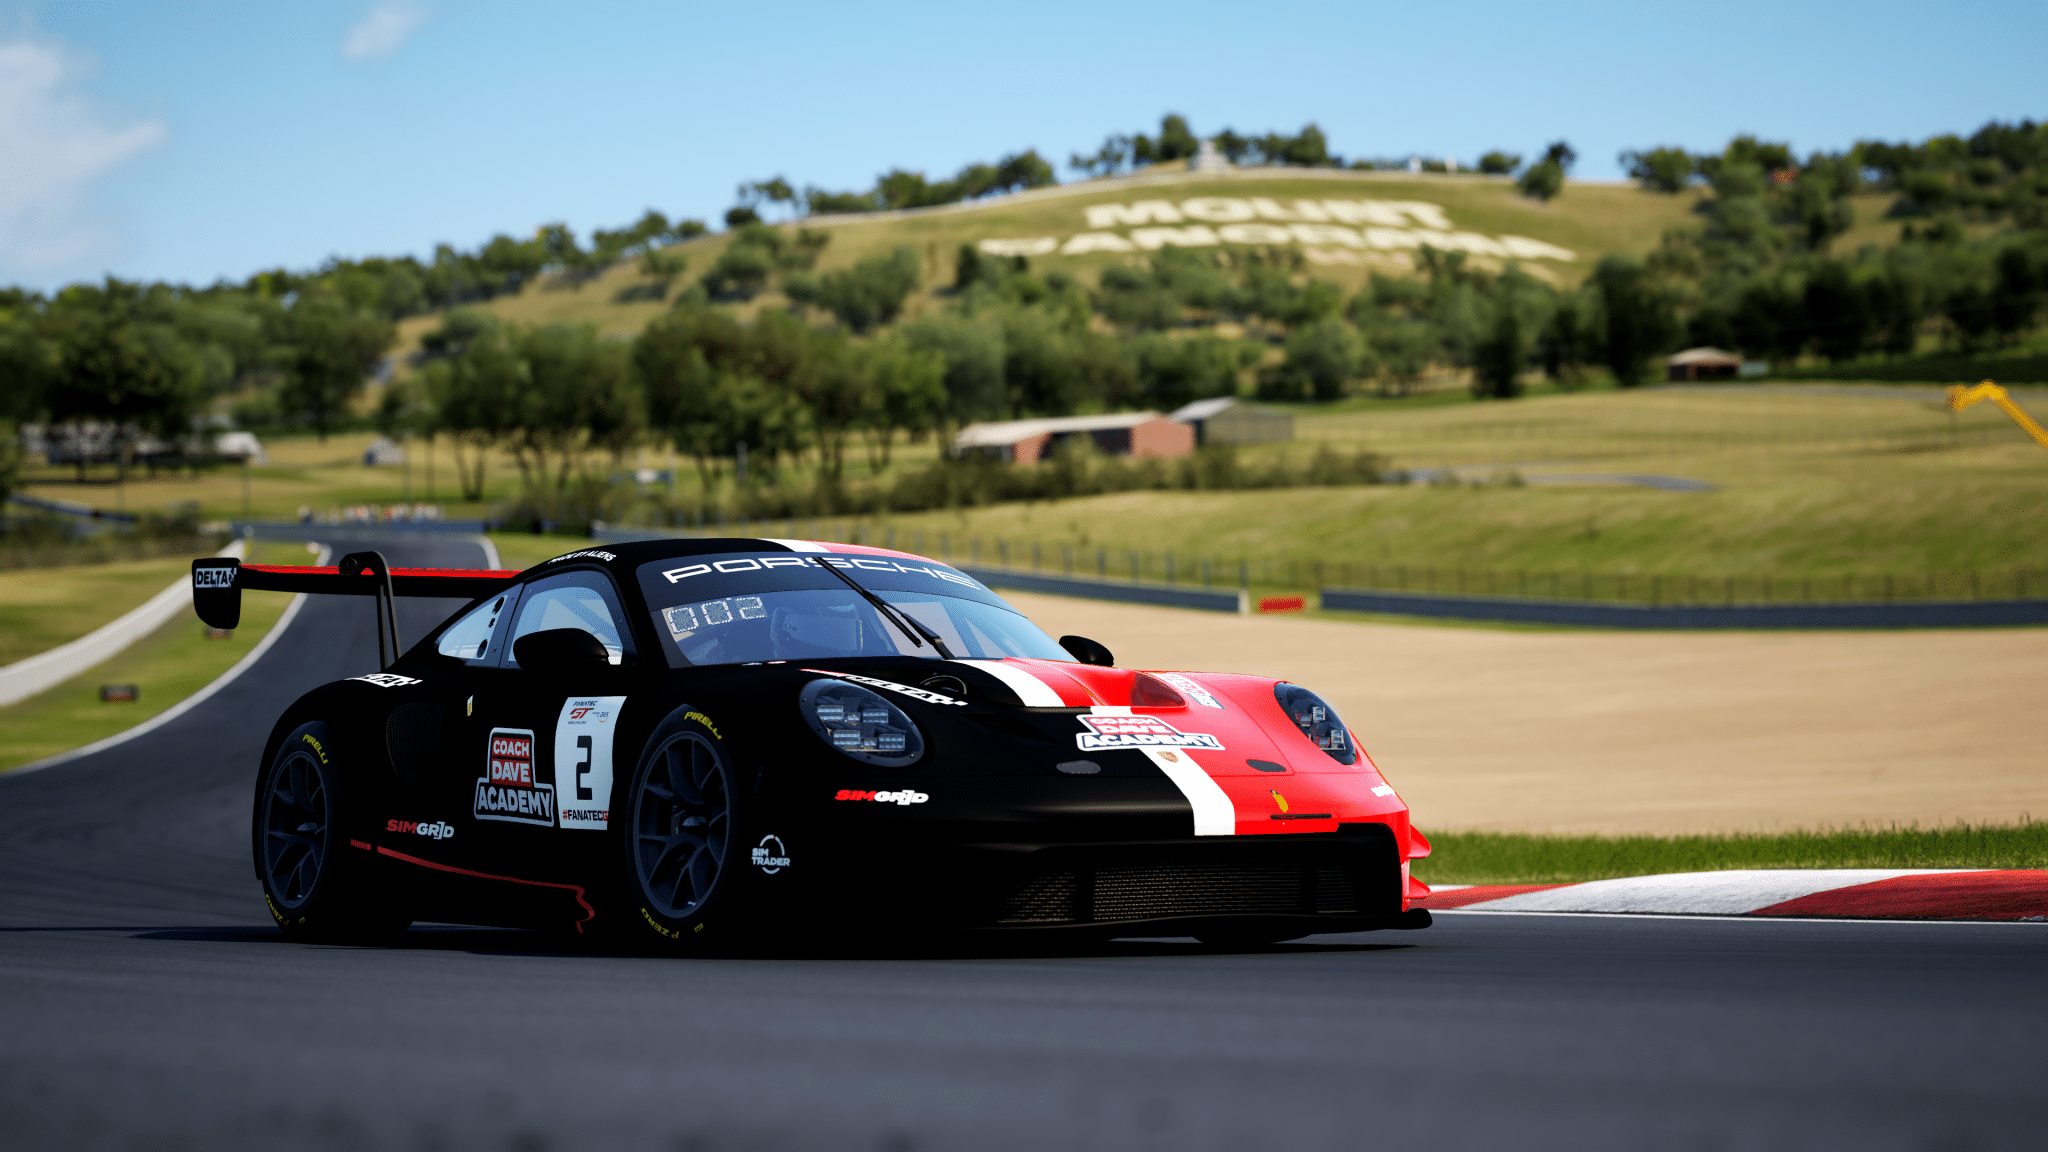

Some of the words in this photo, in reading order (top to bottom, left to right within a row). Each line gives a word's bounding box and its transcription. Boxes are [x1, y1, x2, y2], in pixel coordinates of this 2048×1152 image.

[1085, 196, 1453, 229] MOUNT
[196, 570, 228, 585] DELTA
[661, 556, 981, 591] PORSCHE
[667, 596, 766, 634] 002
[570, 707, 595, 720] GT
[1089, 717, 1160, 725] COACH
[683, 711, 723, 741] PIRELLI
[1096, 725, 1173, 734] DAVE
[302, 733, 329, 765] PIRELLI
[492, 739, 530, 757] COACH
[1083, 734, 1217, 748] ACADEMY
[491, 760, 531, 783] DAVE
[576, 735, 593, 801] 2
[477, 785, 551, 818] ACADEMY
[750, 856, 792, 867] TRADER
[751, 847, 770, 857] SIM
[639, 906, 671, 937] ZERO
